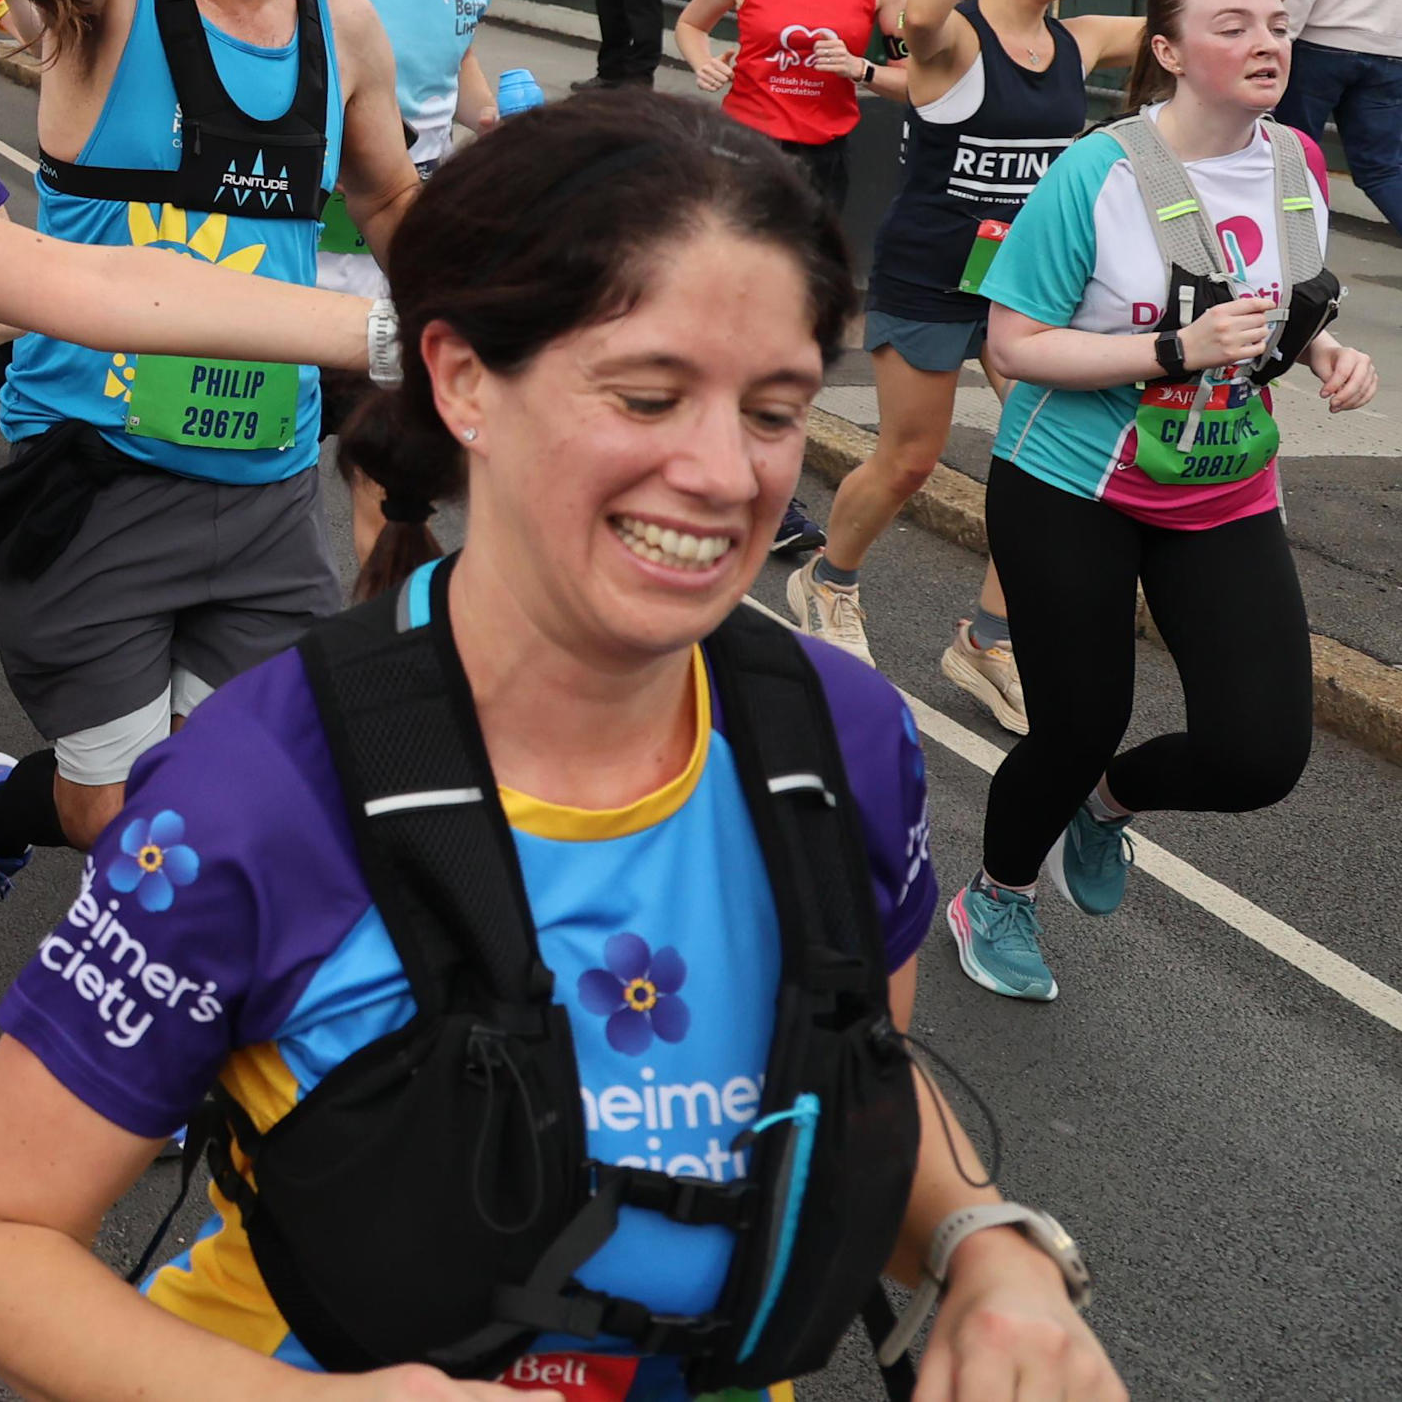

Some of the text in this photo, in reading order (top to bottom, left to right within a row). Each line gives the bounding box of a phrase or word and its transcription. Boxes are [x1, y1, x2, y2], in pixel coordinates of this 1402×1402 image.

[770, 76, 798, 85] British
[771, 84, 821, 96] Foundation
[953, 147, 1050, 179] RETIN
[222, 173, 289, 191] RUNITUDE
[190, 365, 265, 399] PHILIP
[182, 406, 259, 440] 29679
[1180, 452, 1249, 479] 28817
[40, 934, 154, 1048] ciety
